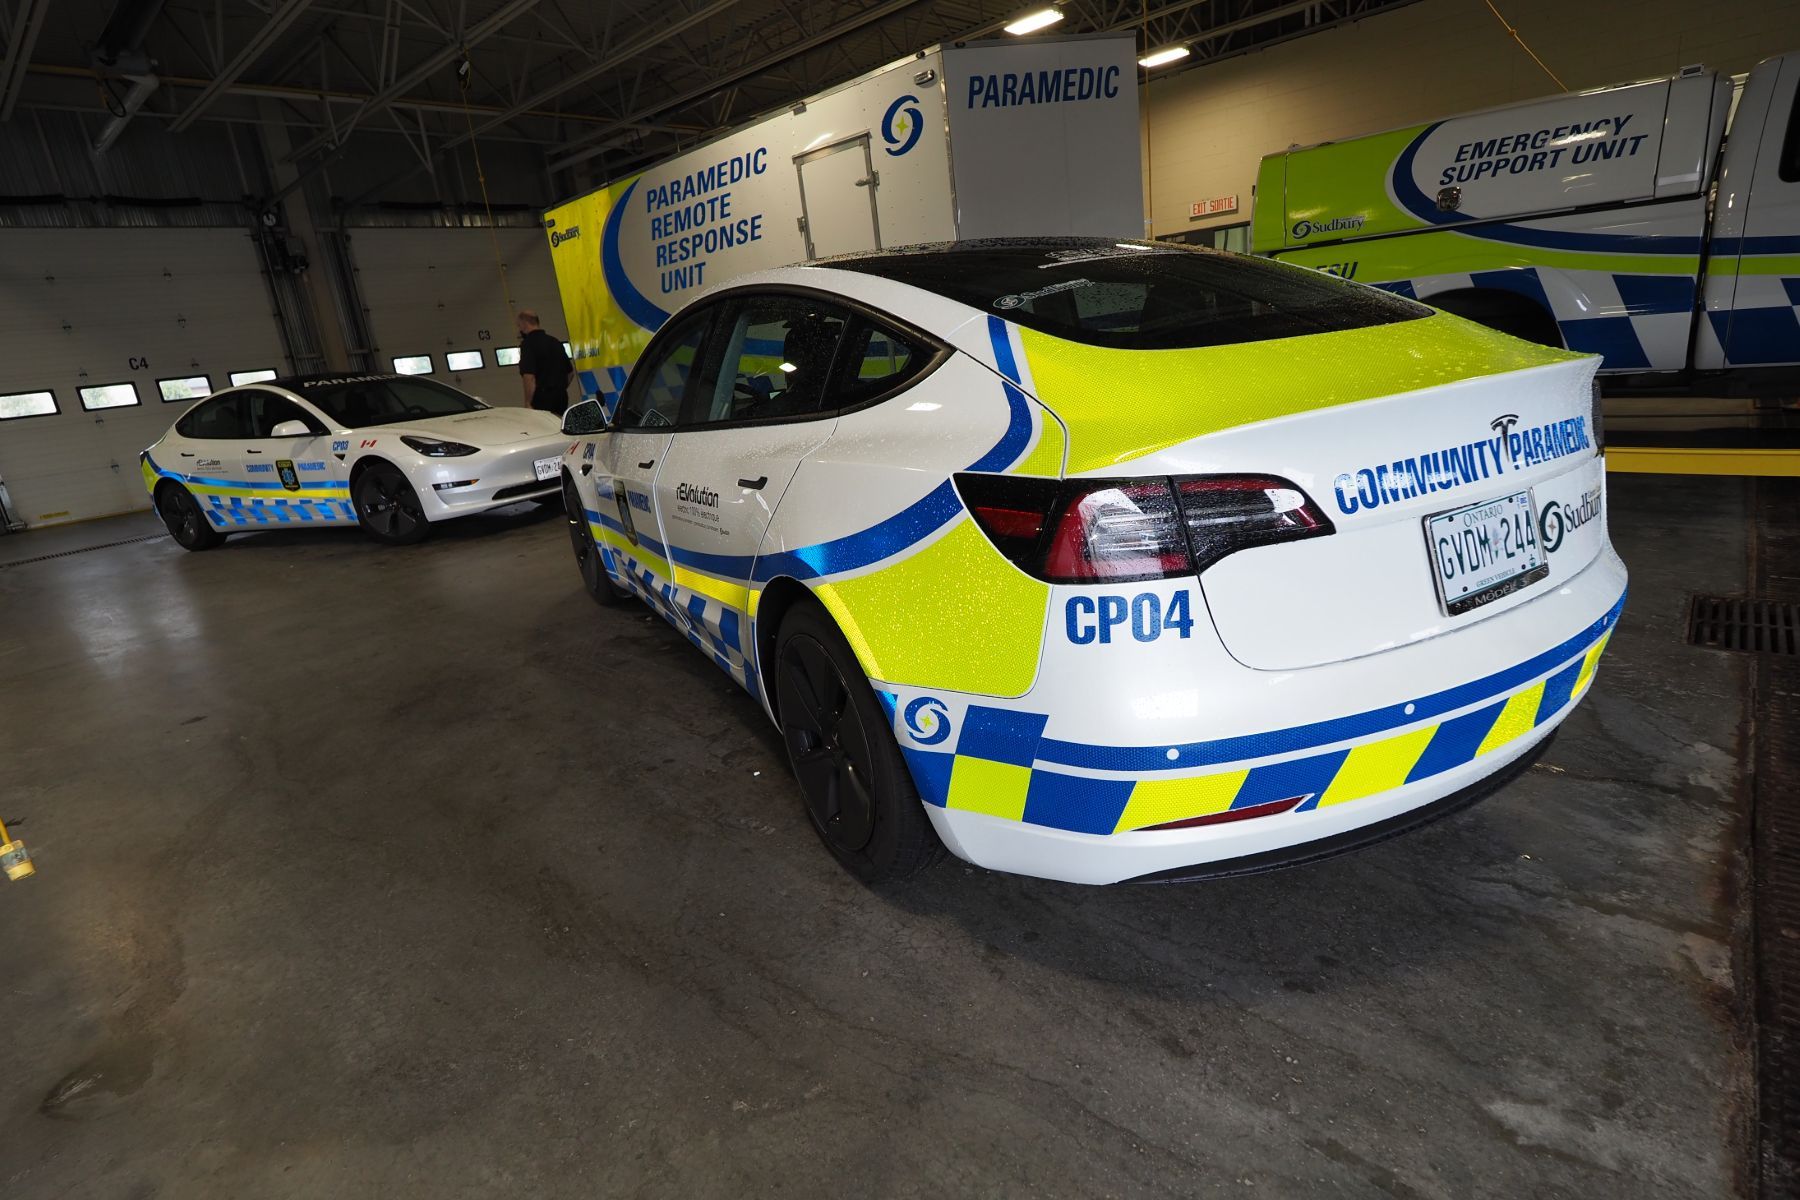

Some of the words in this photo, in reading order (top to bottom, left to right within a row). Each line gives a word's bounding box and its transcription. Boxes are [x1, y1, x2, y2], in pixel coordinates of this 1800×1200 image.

[968, 65, 1120, 109] PARAMEDIC
[1439, 148, 1567, 186] SUPPORT
[1571, 134, 1648, 164] UNIT
[1454, 114, 1634, 163] EMERGENCY
[646, 147, 768, 213] PARAMEDIC
[651, 192, 731, 241] REMOTE
[1193, 202, 1206, 215] EXIT
[1210, 197, 1234, 212] SORTIE
[1313, 218, 1365, 233] Sudbury
[656, 214, 763, 268] RESPONSE
[661, 261, 707, 294] UNIT
[129, 357, 149, 370] C4
[1333, 436, 1505, 515] COMMUNITY
[1508, 415, 1591, 470] PARAMEDIC
[676, 482, 719, 508] rEVolution
[1463, 504, 1503, 528] ONTARIO
[1438, 524, 1493, 580] GVDM
[1500, 510, 1536, 559] 244
[1065, 589, 1194, 645] CP04
